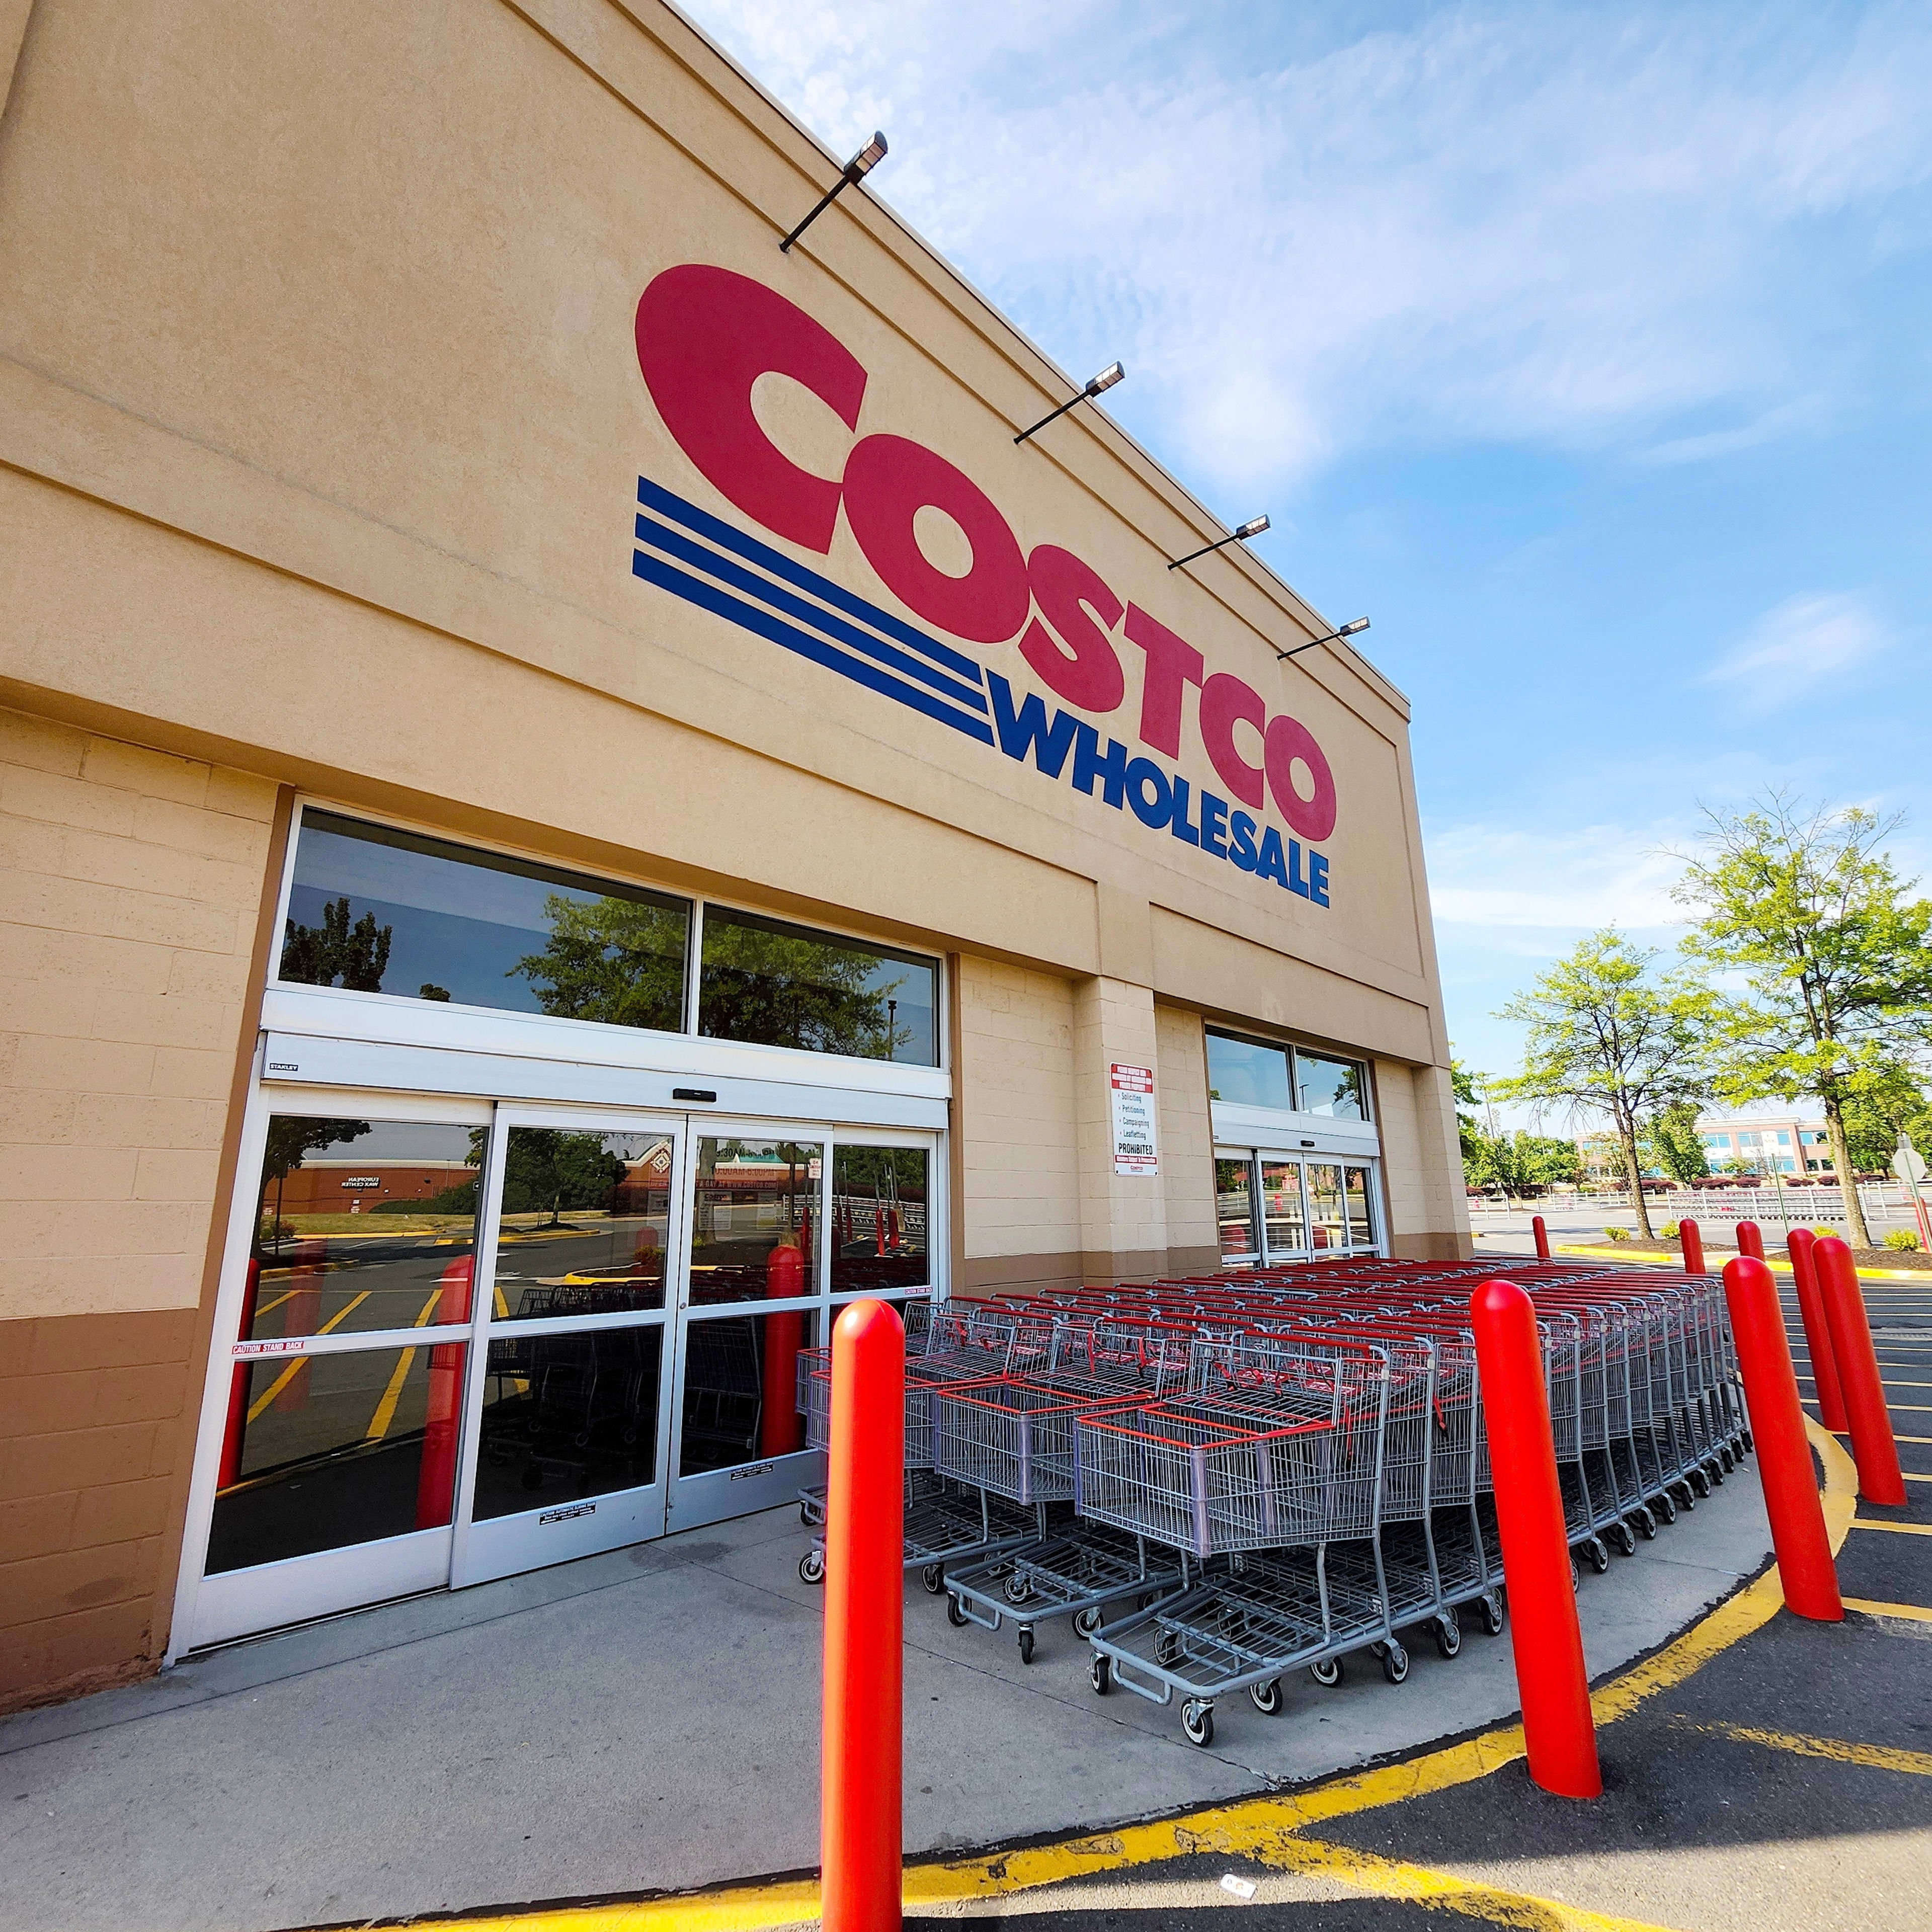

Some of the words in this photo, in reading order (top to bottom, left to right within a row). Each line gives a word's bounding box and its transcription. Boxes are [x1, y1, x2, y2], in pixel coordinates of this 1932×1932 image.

[635, 264, 1337, 842] COSTCO
[986, 668, 1330, 909] WHOLESALE
[1121, 1092, 1142, 1103] Soliciting
[1122, 1104, 1145, 1116] Petitioning
[1123, 1117, 1149, 1129] Campaigning
[1123, 1129, 1146, 1140] Leafletting
[1118, 1143, 1153, 1155] PROHIBITED
[233, 1345, 260, 1354] CAUTION
[263, 1343, 284, 1352] STAND
[286, 1341, 303, 1349] BACK
